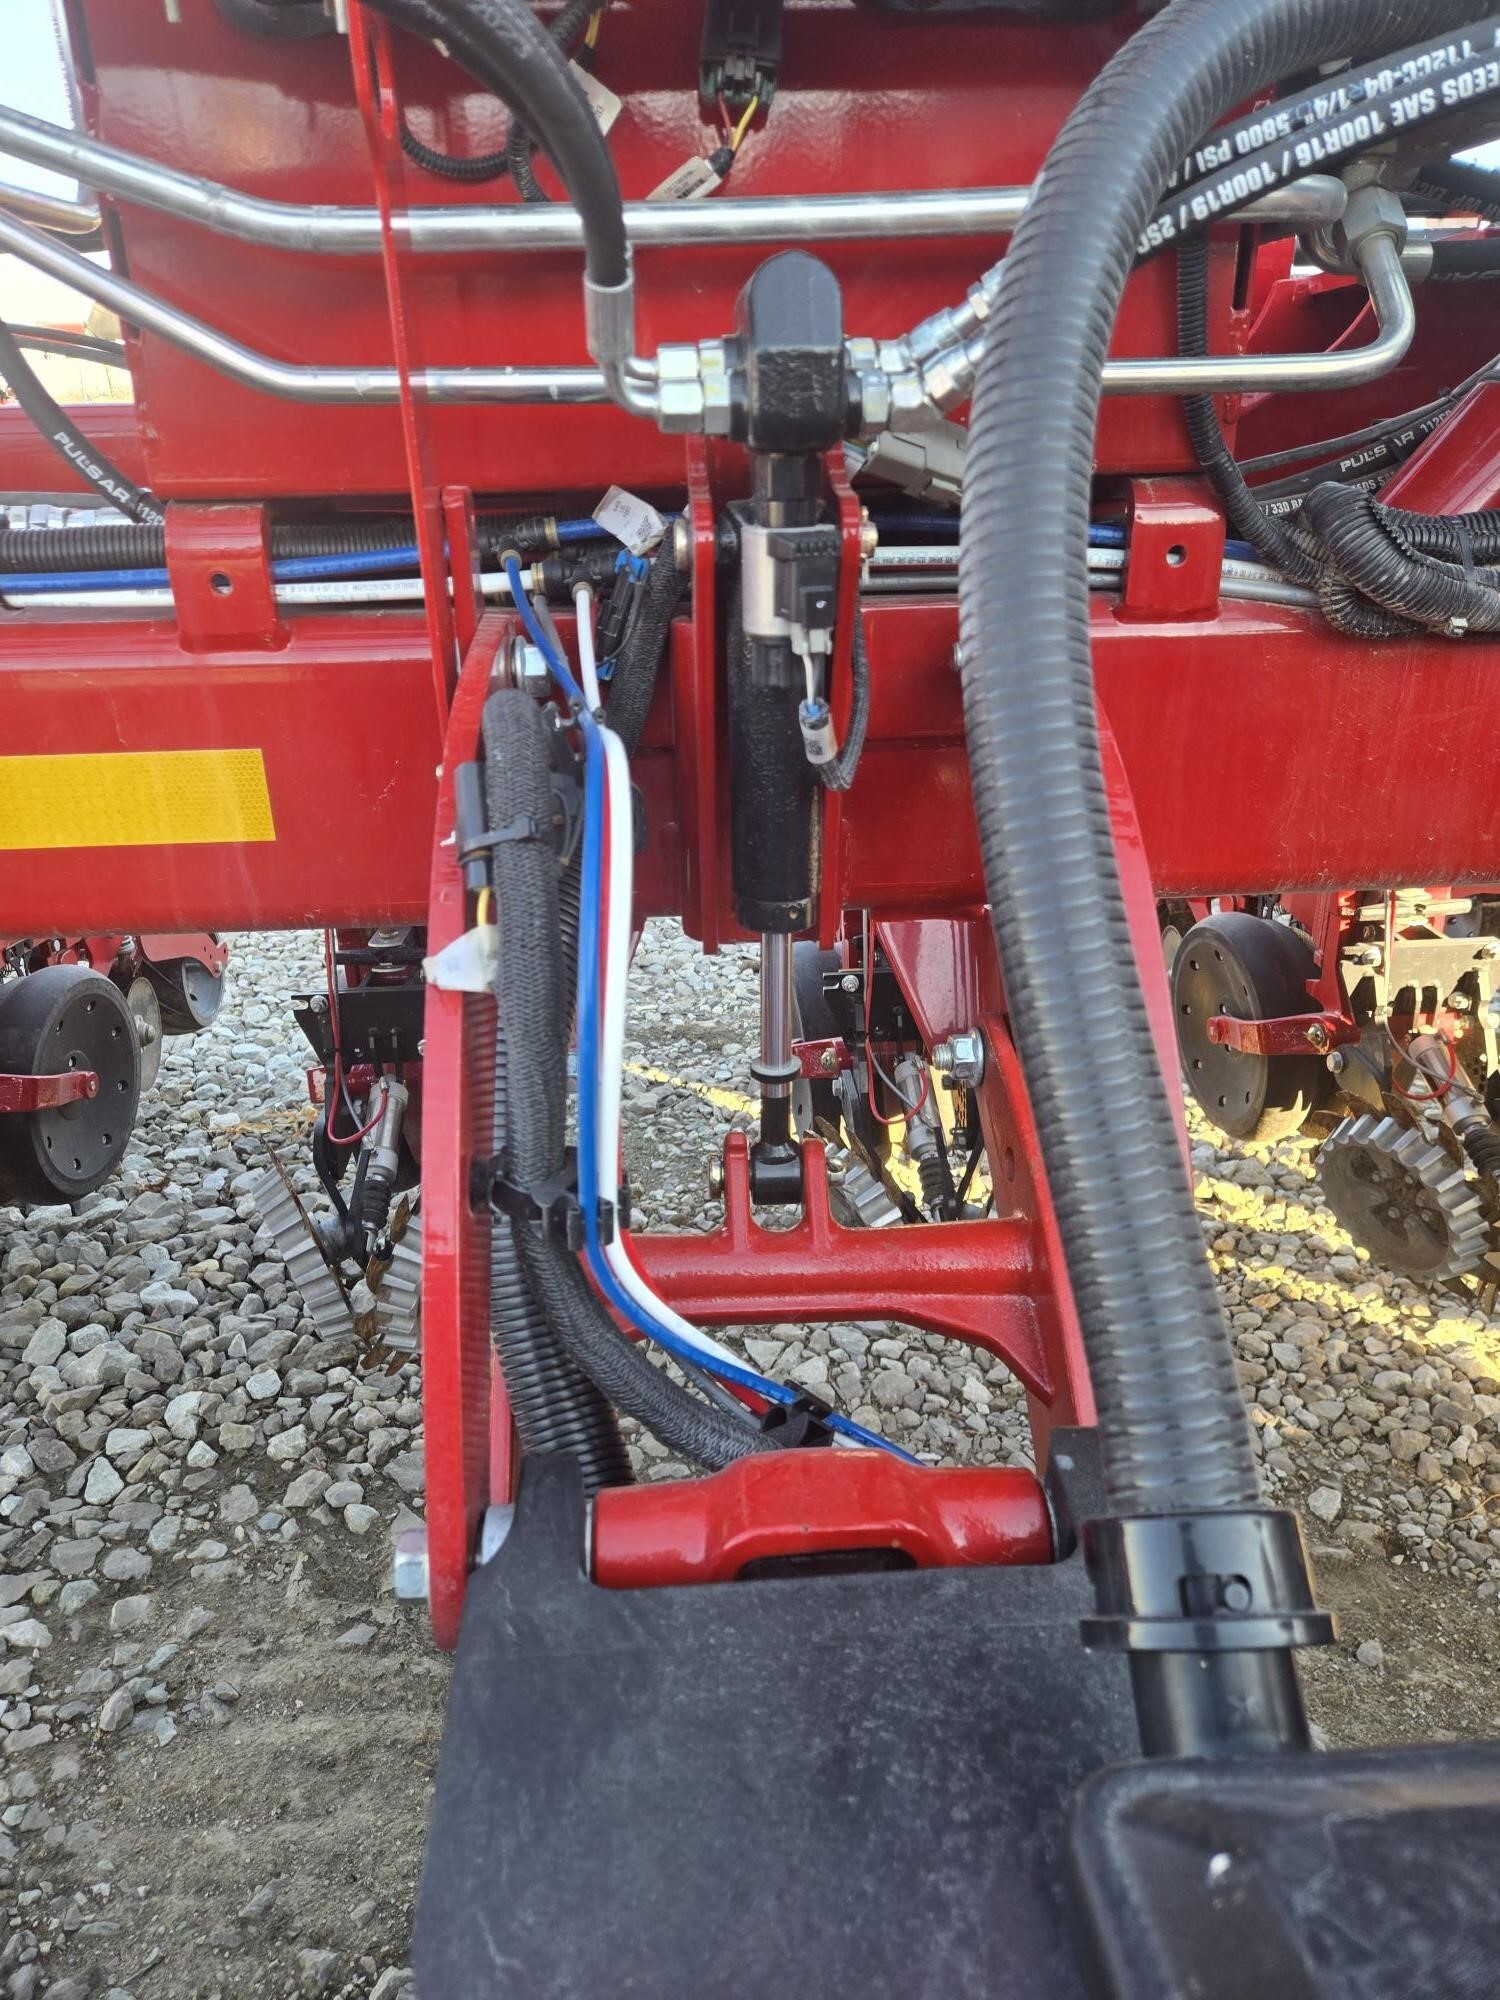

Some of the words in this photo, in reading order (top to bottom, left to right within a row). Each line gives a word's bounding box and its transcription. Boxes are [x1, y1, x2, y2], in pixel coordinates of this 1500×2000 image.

[1389, 88, 1437, 127] SAE
[1197, 141, 1233, 174] PSI
[1236, 113, 1291, 153] 5800
[1294, 110, 1387, 168] 100R16
[1193, 161, 1278, 221] 100R19
[53, 431, 130, 503] PULSAR
